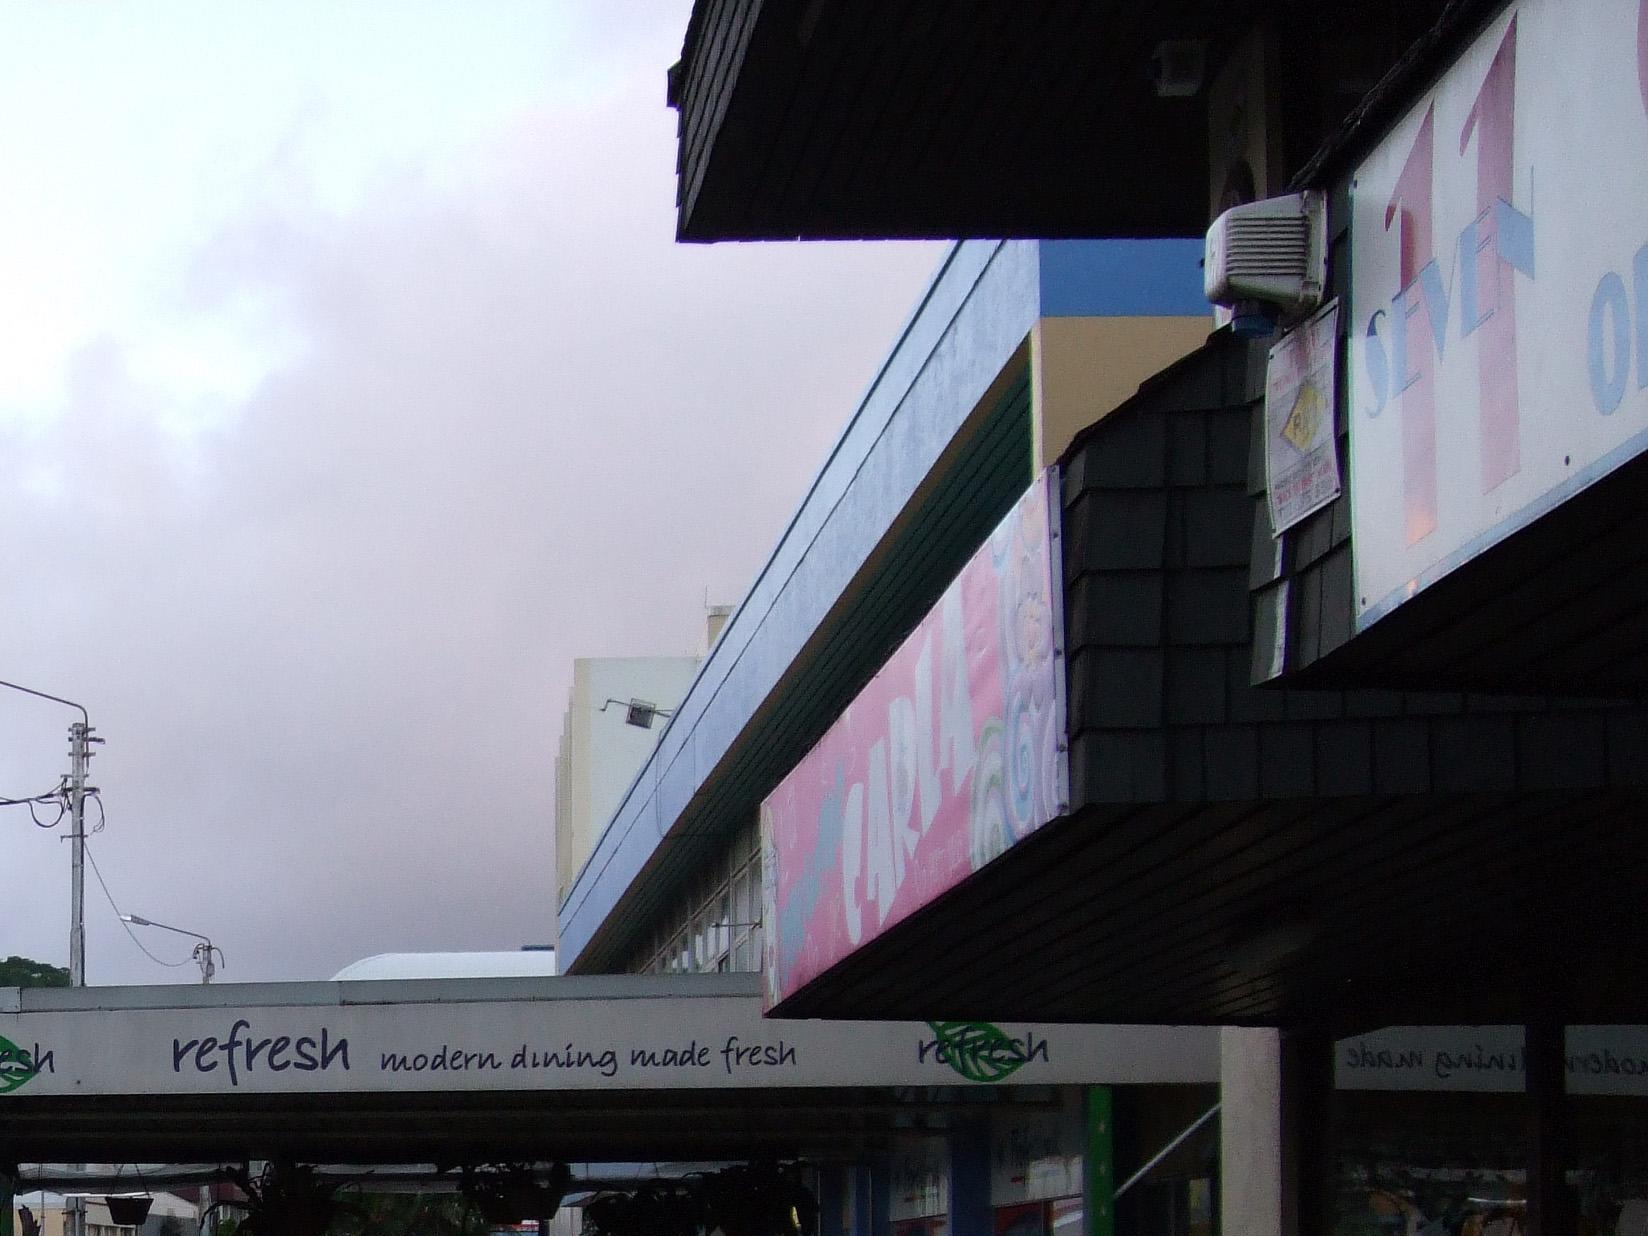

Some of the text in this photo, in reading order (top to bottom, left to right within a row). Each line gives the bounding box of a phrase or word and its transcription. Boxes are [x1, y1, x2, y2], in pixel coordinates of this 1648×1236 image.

[172, 1019, 351, 1086] refresh
[380, 1036, 798, 1077] modern dining made fresh
[917, 1024, 1051, 1070] refresh
